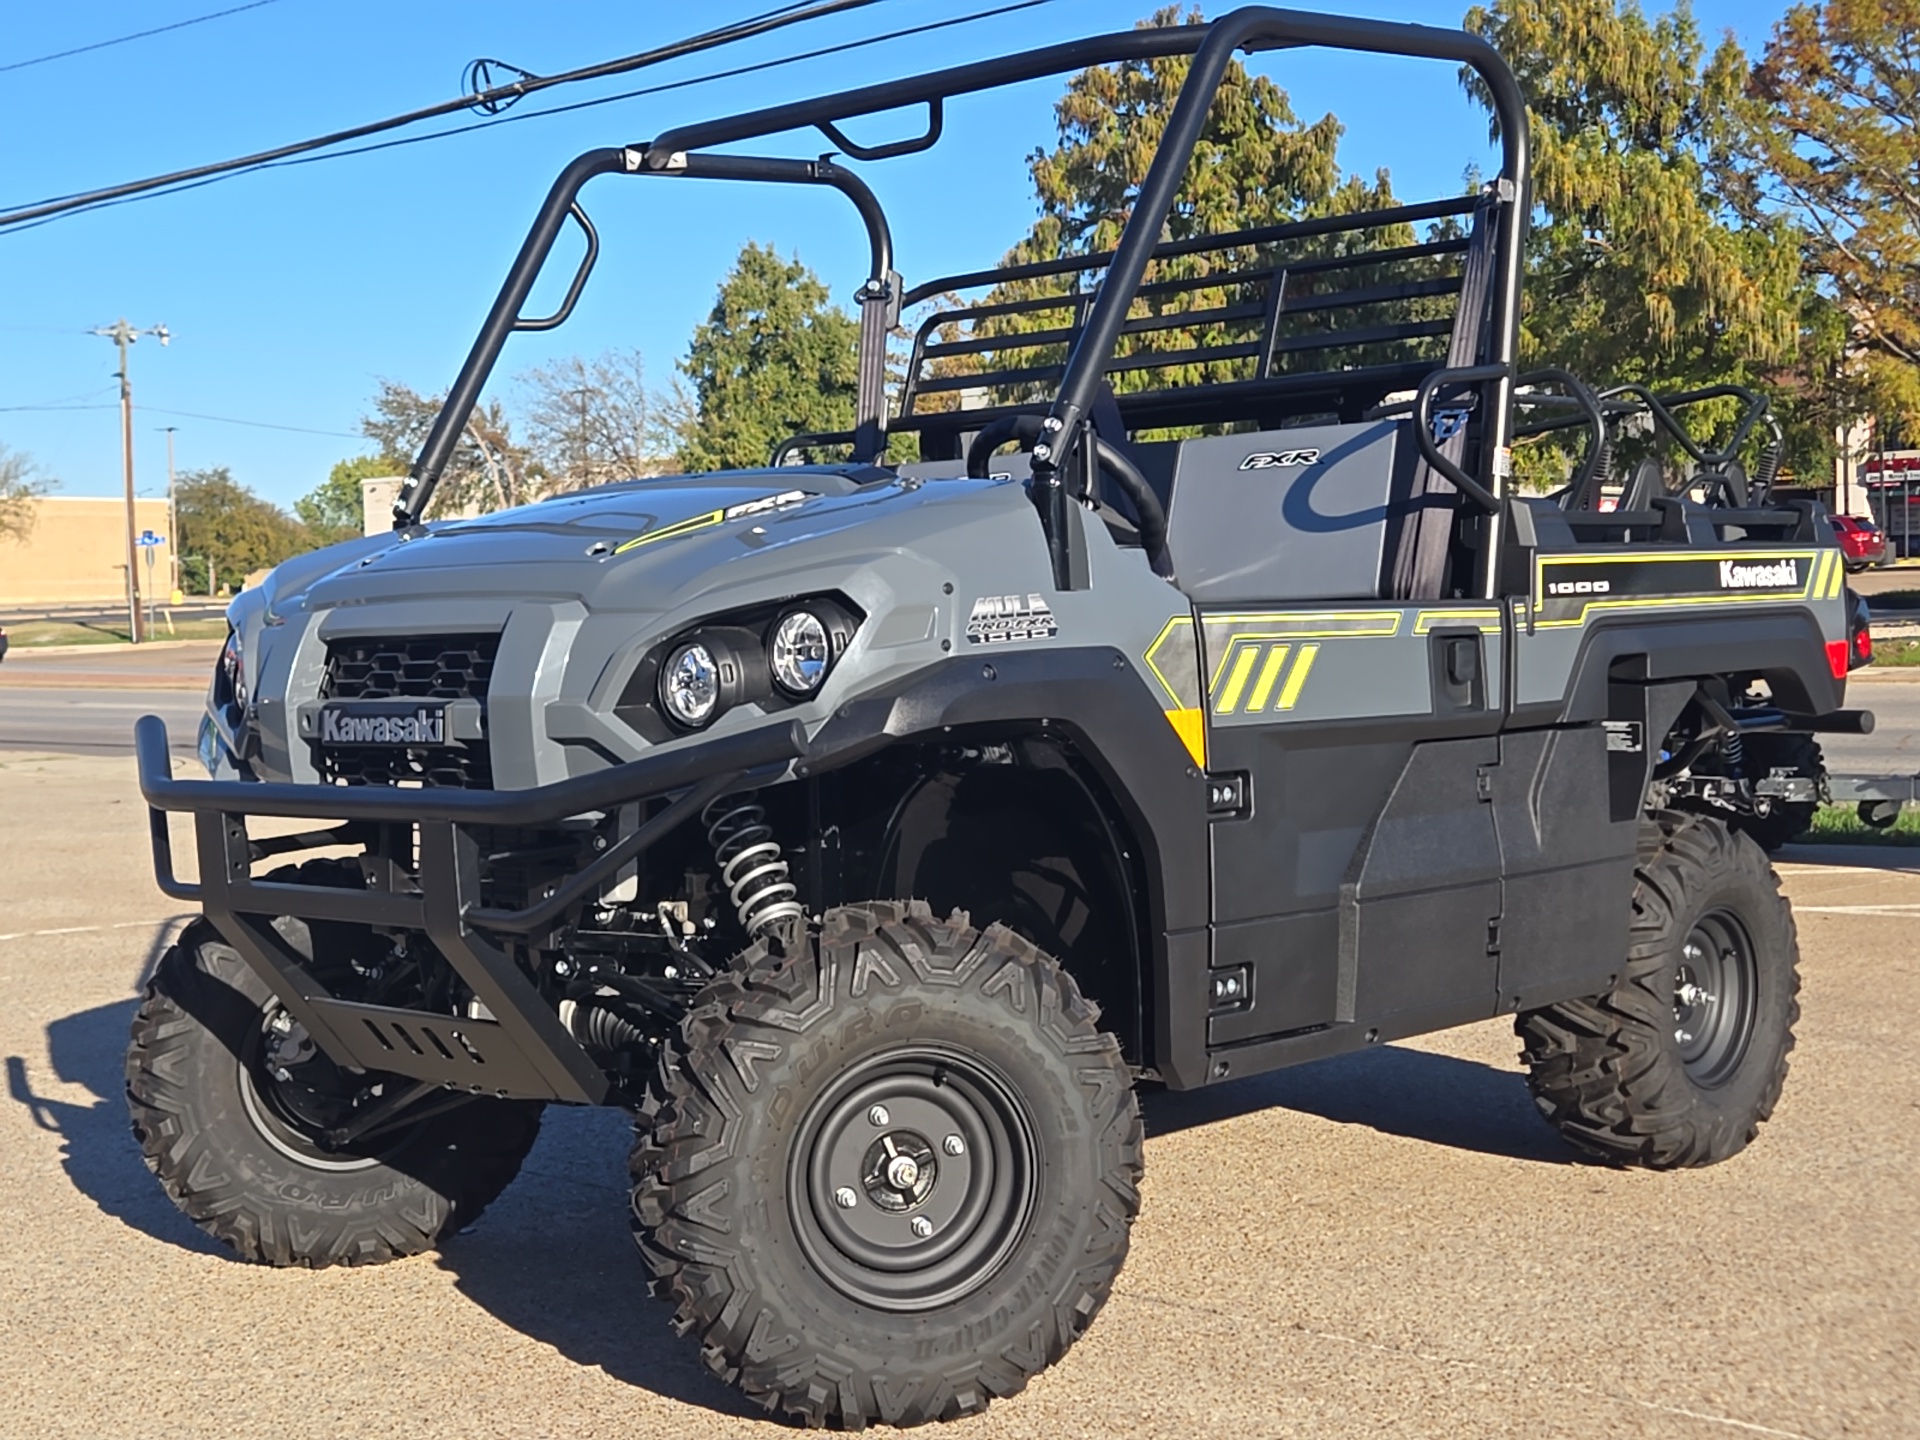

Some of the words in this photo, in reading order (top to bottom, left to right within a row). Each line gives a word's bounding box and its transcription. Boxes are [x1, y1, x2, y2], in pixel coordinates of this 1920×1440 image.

[1239, 448, 1320, 470] FXR
[1719, 559, 1798, 588] Kawasaki
[1548, 581, 1610, 594] 1000
[969, 594, 1052, 621] MULE
[323, 709, 444, 742] Kawasaki
